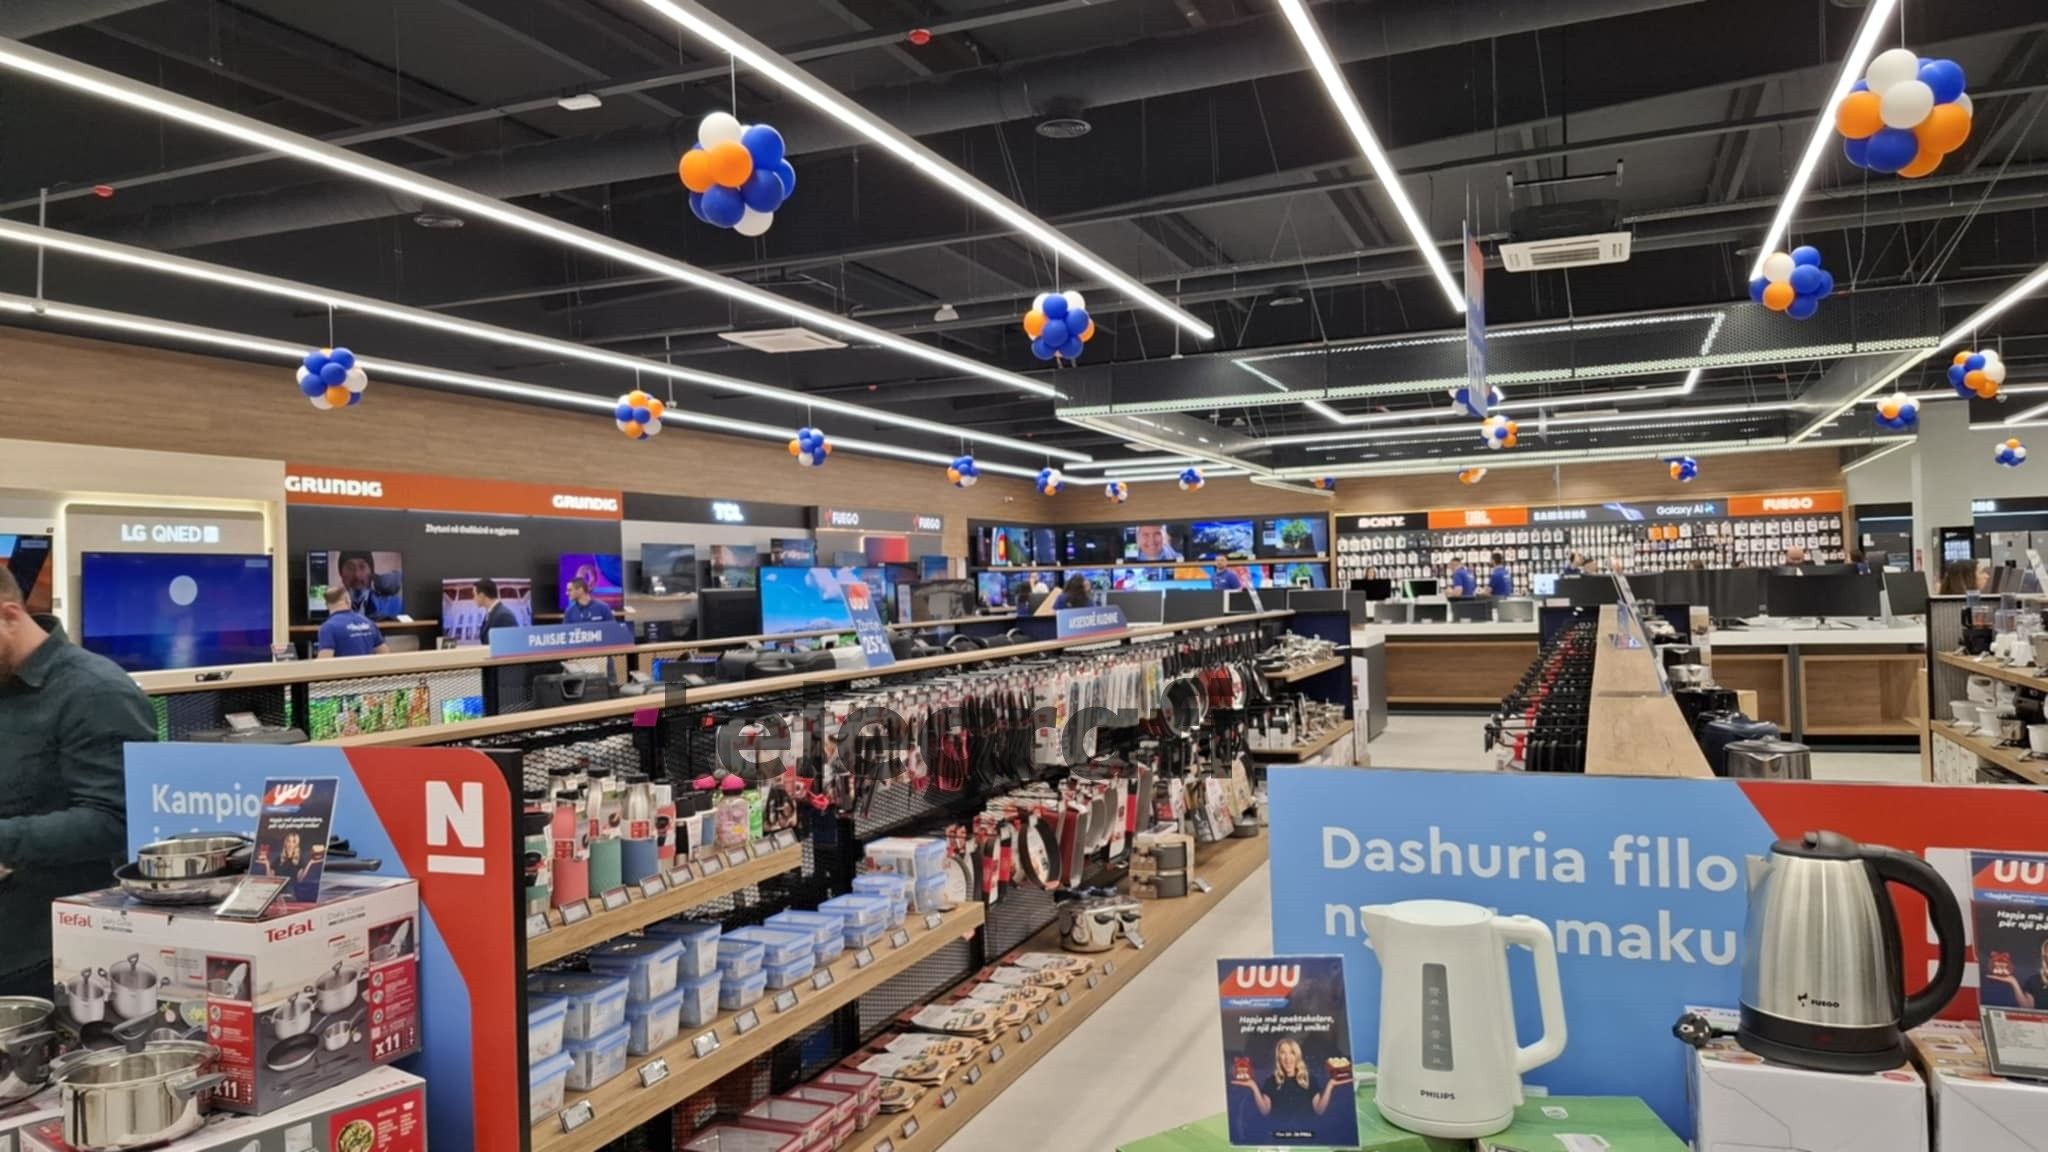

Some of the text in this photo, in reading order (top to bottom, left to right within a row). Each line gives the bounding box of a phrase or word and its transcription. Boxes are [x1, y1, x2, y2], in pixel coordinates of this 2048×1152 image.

[285, 476, 382, 497] GRUNDIG
[552, 495, 617, 511] GRUNDIG
[1656, 505, 1692, 517] Galaxy
[1762, 498, 1813, 510] FUEGO
[832, 512, 859, 525] FUEGO
[919, 517, 941, 530] FUEGO
[1358, 516, 1405, 529] SONY
[1533, 510, 1587, 521] SAMSUNG
[121, 524, 201, 543] LG QNED
[528, 628, 602, 647] PAJISJE ZËRIMI
[152, 782, 260, 823] Kampio
[425, 780, 485, 849] N
[1322, 826, 1586, 884] Dashuria
[57, 911, 92, 928] Tefal
[1997, 909, 2044, 922] Hapja më
[264, 919, 315, 943] Tefal
[1997, 920, 2017, 929] për
[2018, 920, 2034, 931] një
[1554, 910, 1737, 966] maku
[1236, 964, 1301, 989] UUU
[1810, 999, 1841, 1009] FUEGO
[374, 1032, 400, 1056] x11
[1420, 1089, 1456, 1101] PHILIPS
